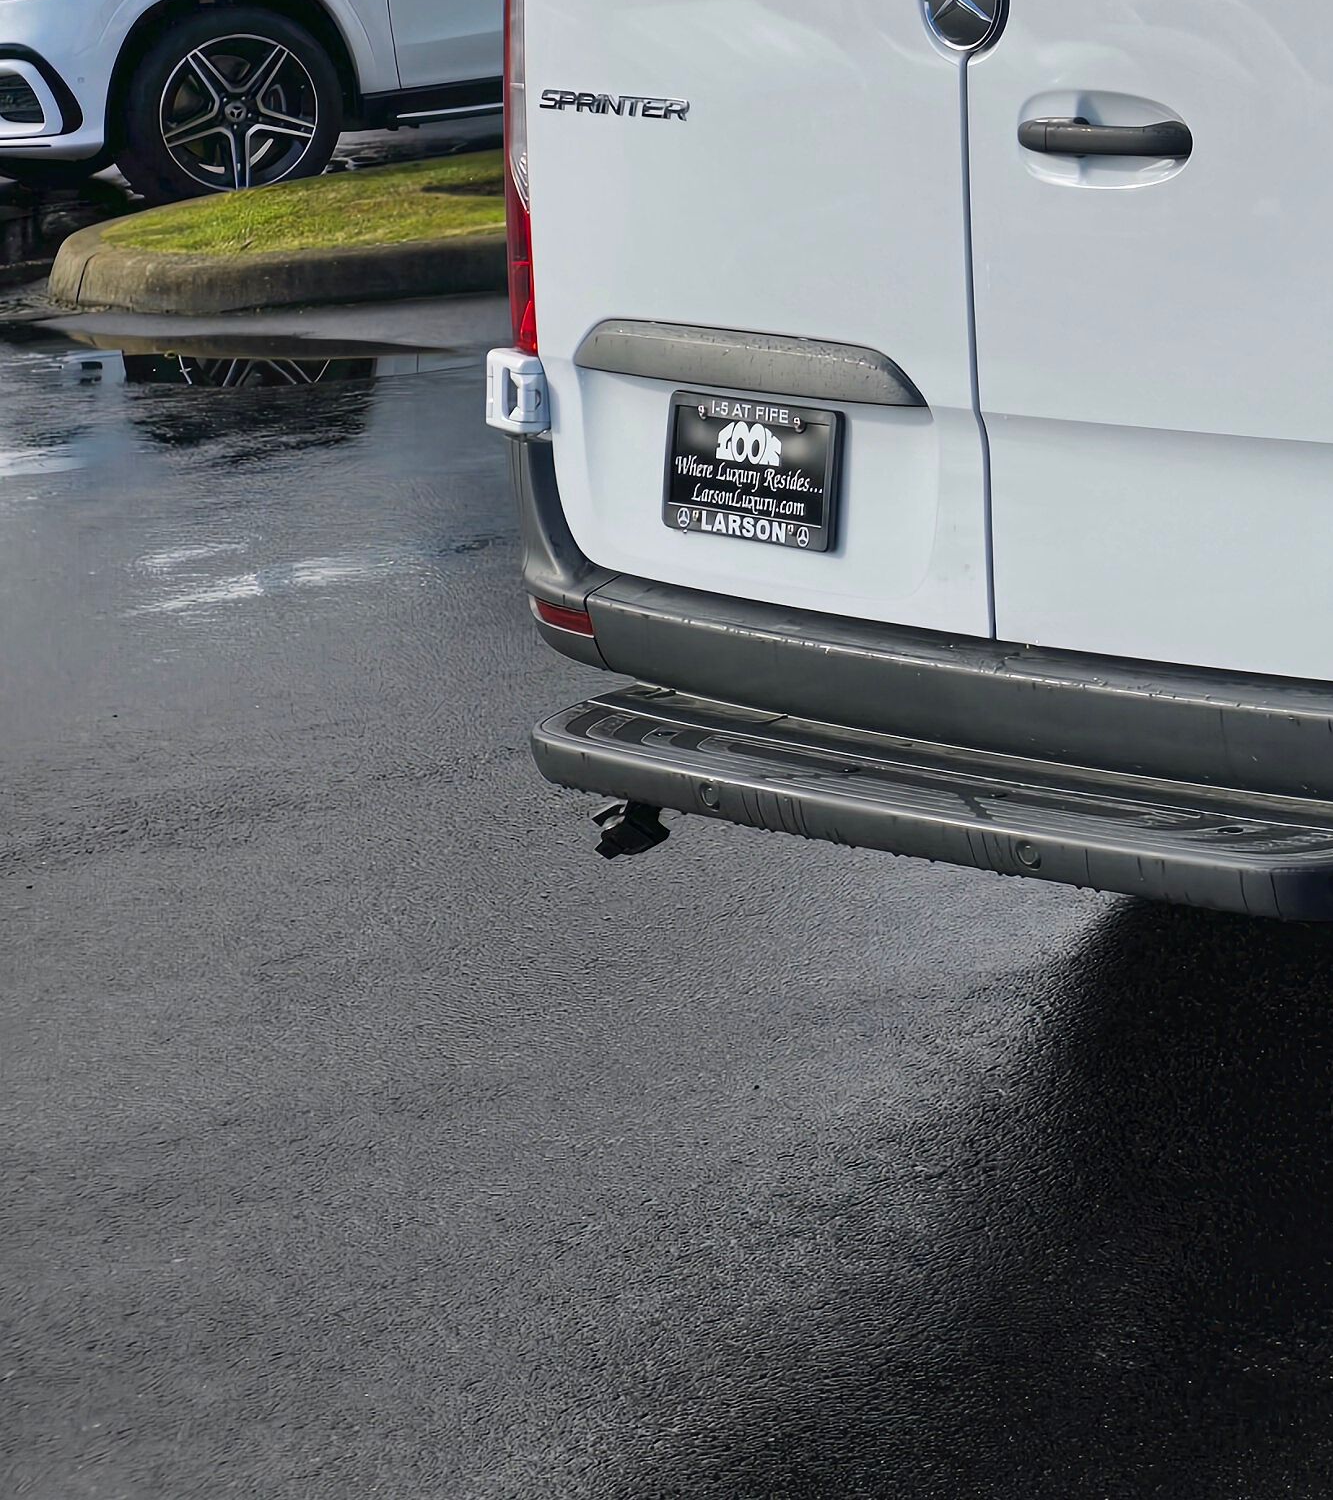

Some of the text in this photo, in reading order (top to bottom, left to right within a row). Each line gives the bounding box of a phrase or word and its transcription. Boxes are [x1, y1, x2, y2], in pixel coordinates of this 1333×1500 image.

[539, 88, 690, 122] SPRINTER
[711, 400, 789, 424] I-5 AT FIFE
[675, 454, 823, 494] Where Luxury Resides...
[691, 483, 805, 517] LarsonLuxury.com
[701, 511, 787, 544] LARSON
